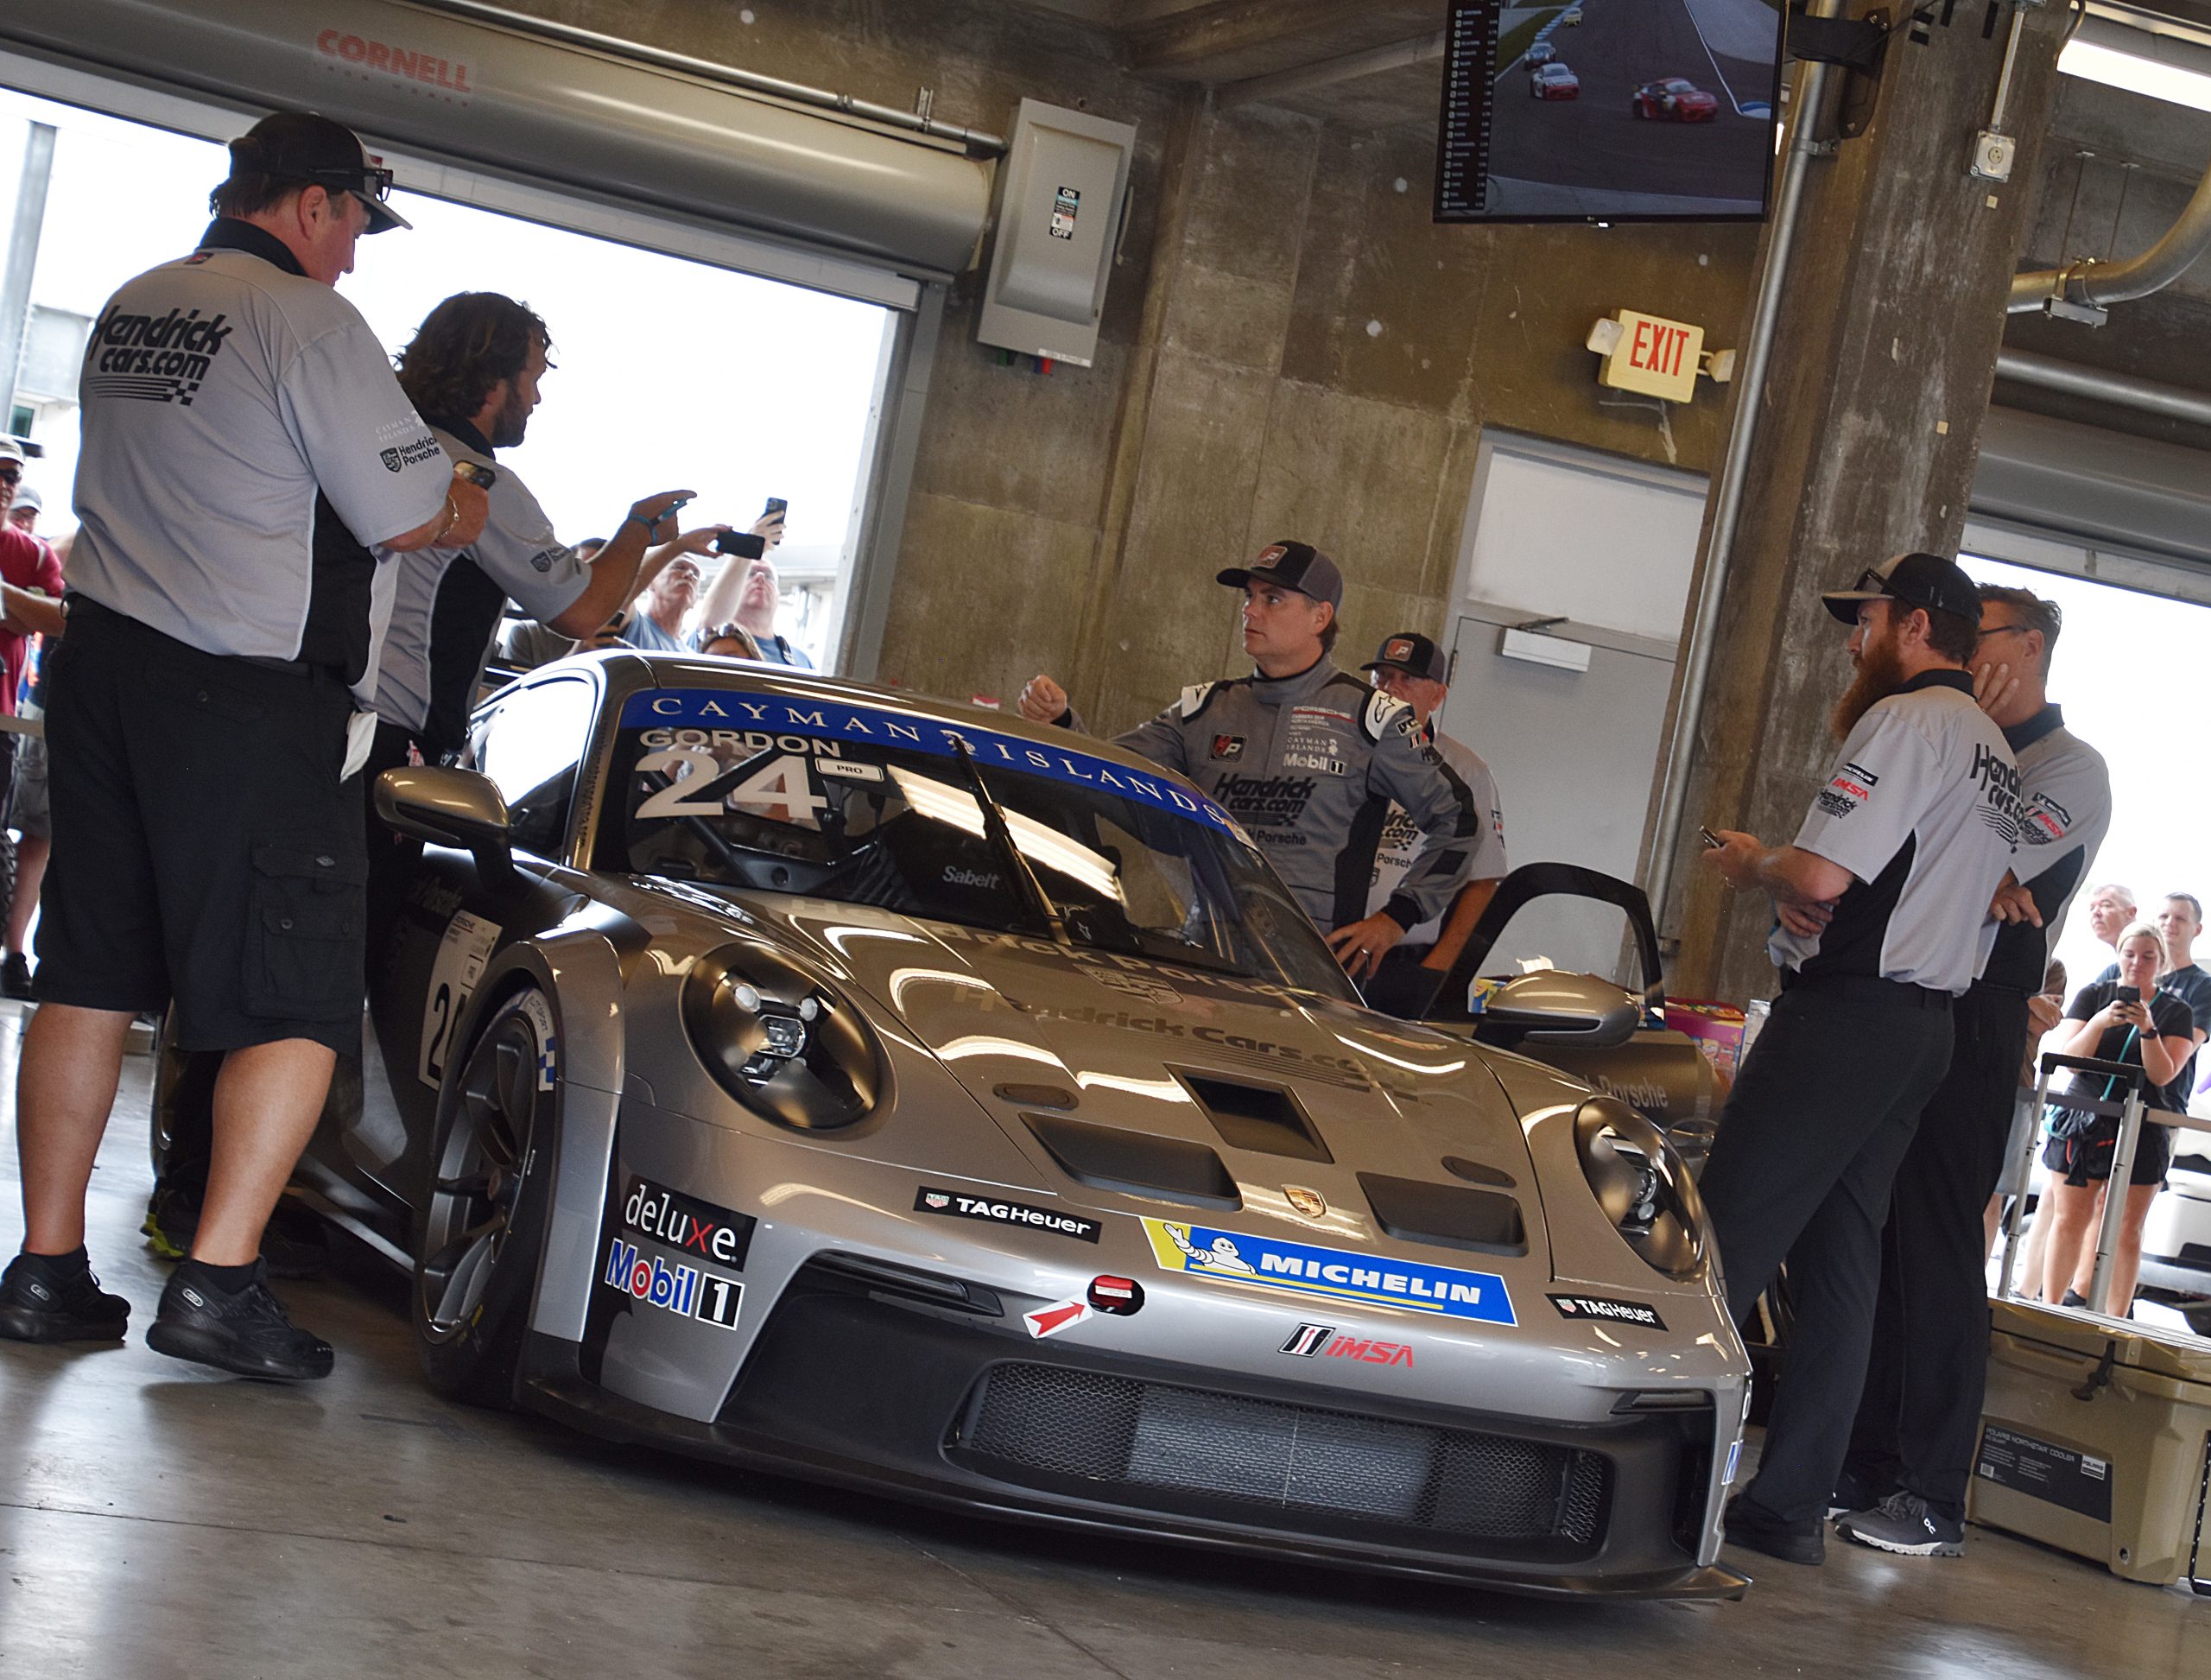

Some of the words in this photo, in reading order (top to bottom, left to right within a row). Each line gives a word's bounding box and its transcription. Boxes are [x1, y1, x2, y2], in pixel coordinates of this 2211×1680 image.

[317, 29, 472, 94] CORNELL
[1062, 188, 1076, 199] ON
[1052, 227, 1070, 238] OFF
[1630, 320, 1690, 377] EXIT
[99, 347, 211, 380] cars.com
[402, 447, 440, 466] Porsche
[639, 729, 842, 758] GORDON
[1287, 736, 1327, 746] CAYMAN
[651, 697, 922, 743] CAYMAN
[993, 743, 1226, 825] ISLANDS
[835, 764, 864, 775] PRO
[1283, 753, 1328, 770] Mobil
[1969, 743, 2021, 798] Hend
[634, 750, 828, 820] 24
[1213, 772, 1317, 802] Hendrick
[1228, 796, 1306, 814] cars.com
[1257, 830, 1307, 846] Porsche
[1378, 853, 1411, 868] Porsch
[942, 865, 999, 890] Sabelt
[1191, 1025, 1360, 1074] Cars.co
[604, 1236, 699, 1318] Mobil
[1259, 1252, 1482, 1305] MICHELIN
[1986, 1427, 2011, 1441] POLARIS
[2011, 1436, 2049, 1454] NORTHSTAR
[2049, 1449, 2075, 1462] COOLER
